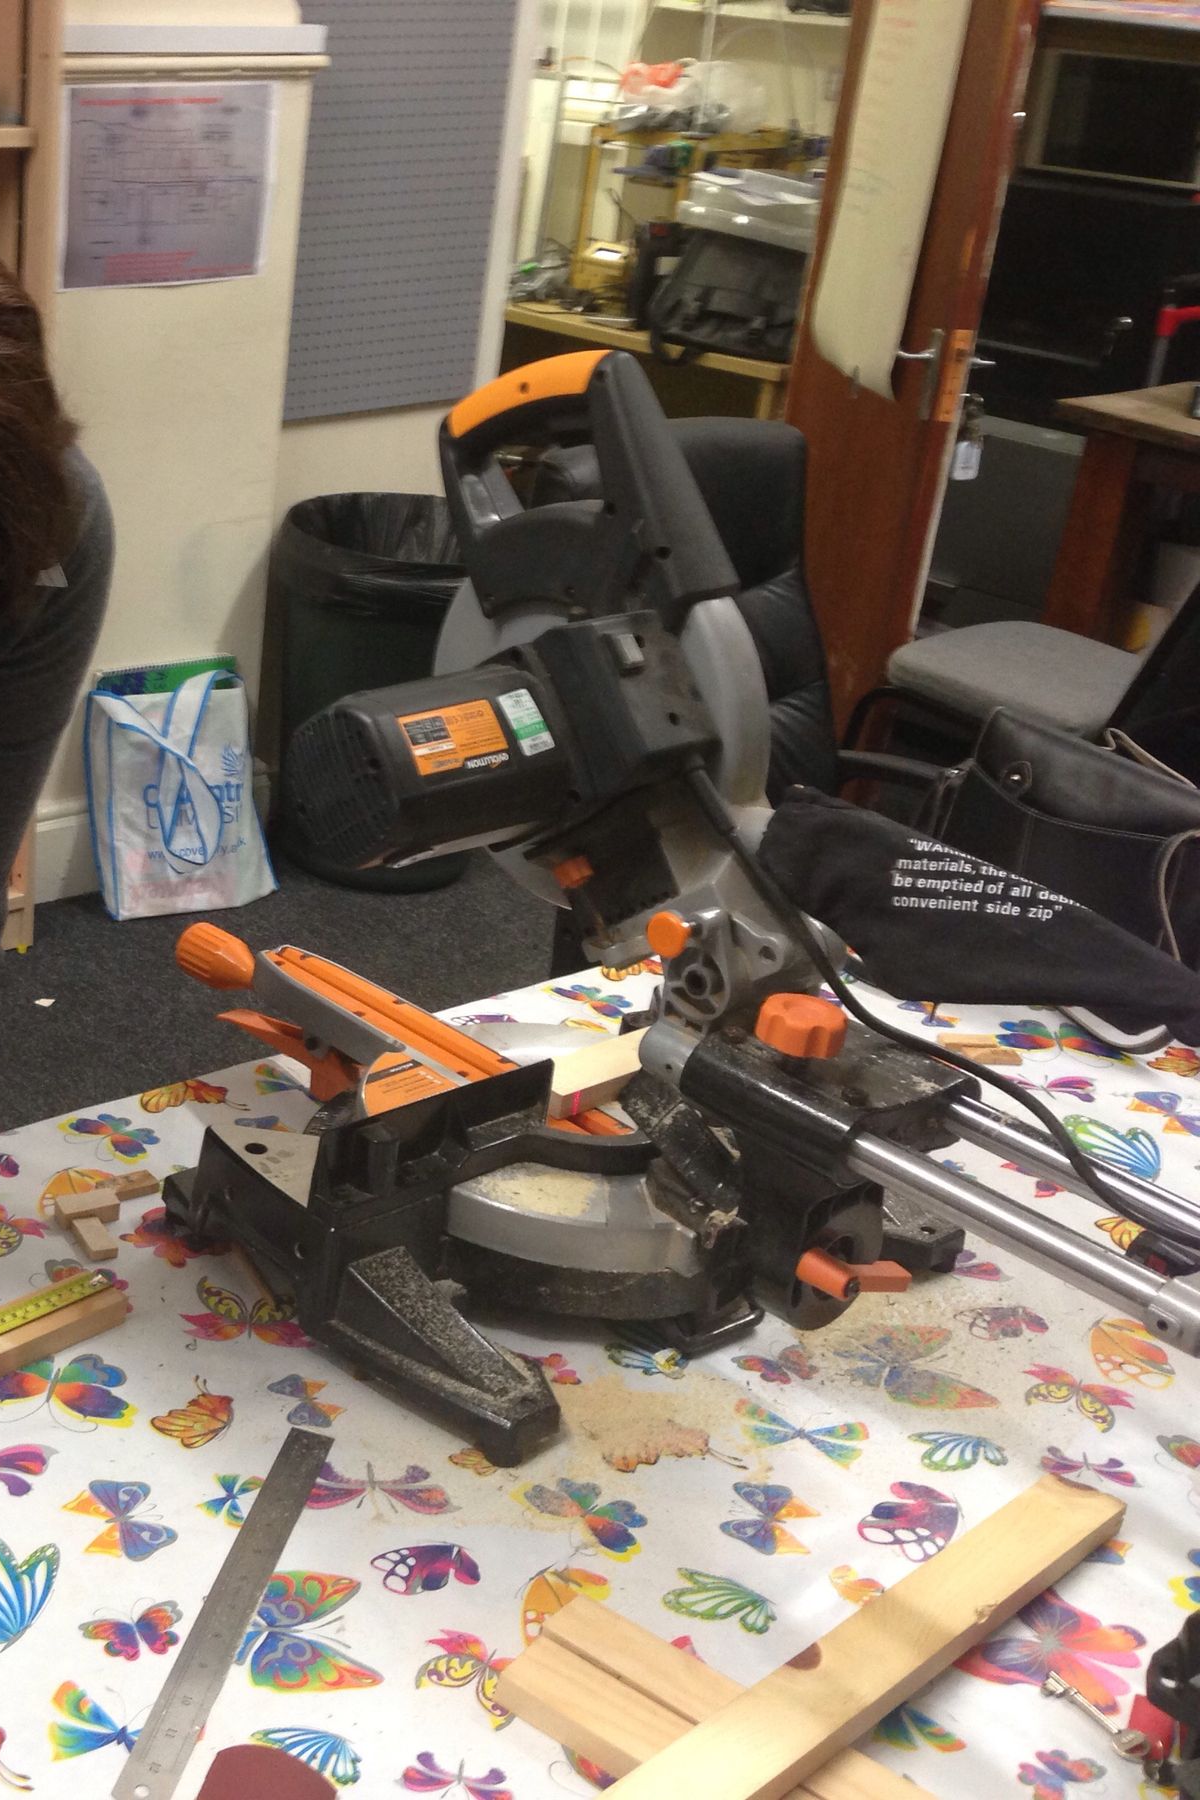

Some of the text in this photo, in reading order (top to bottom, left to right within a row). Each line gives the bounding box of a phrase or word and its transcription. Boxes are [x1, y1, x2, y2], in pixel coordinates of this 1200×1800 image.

[897, 858, 977, 875] materials,
[892, 873, 913, 888] be
[917, 878, 984, 893] emptied
[987, 881, 1006, 895] of
[1010, 885, 1032, 898] all
[892, 896, 979, 912] convenient
[985, 900, 1021, 916] side
